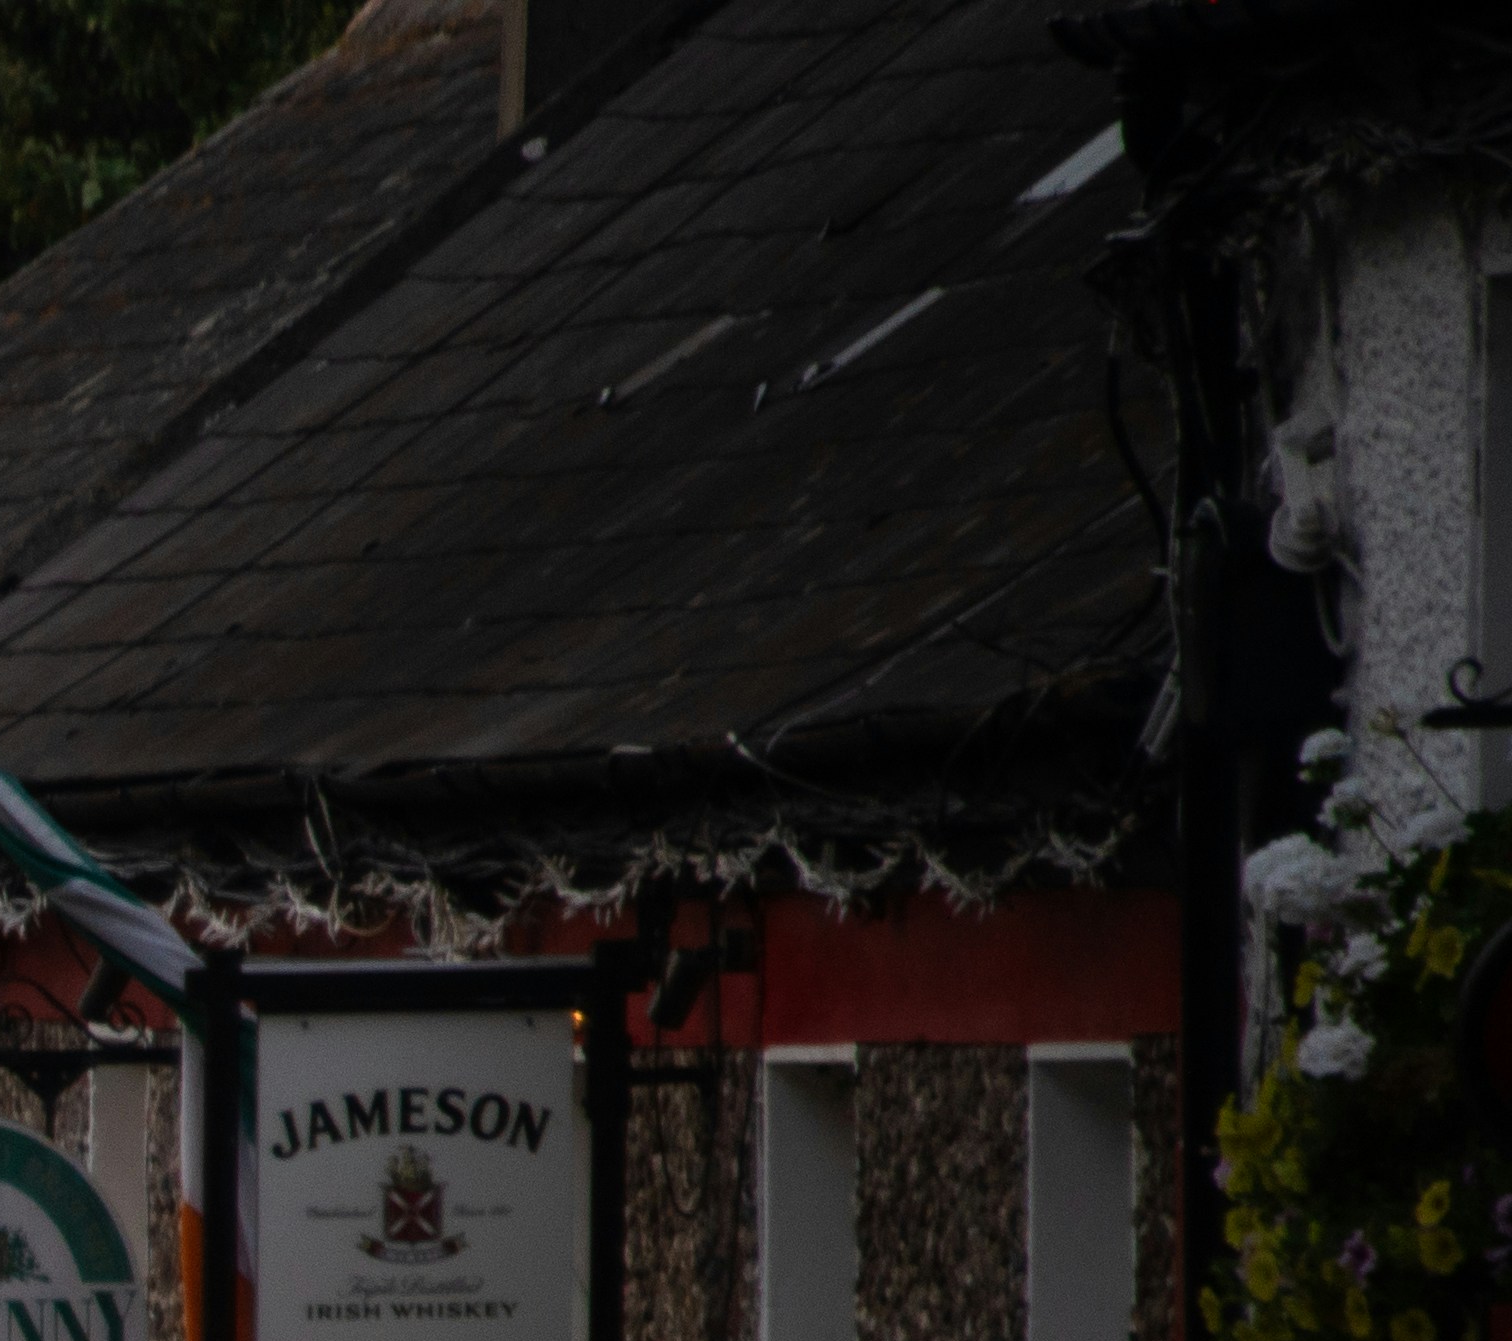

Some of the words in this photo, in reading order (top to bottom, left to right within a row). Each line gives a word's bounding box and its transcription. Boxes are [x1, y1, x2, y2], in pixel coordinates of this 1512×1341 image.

[271, 1086, 551, 1159] JAMESON
[306, 1302, 381, 1321] IRISH
[392, 1301, 517, 1320] WHISKEY
